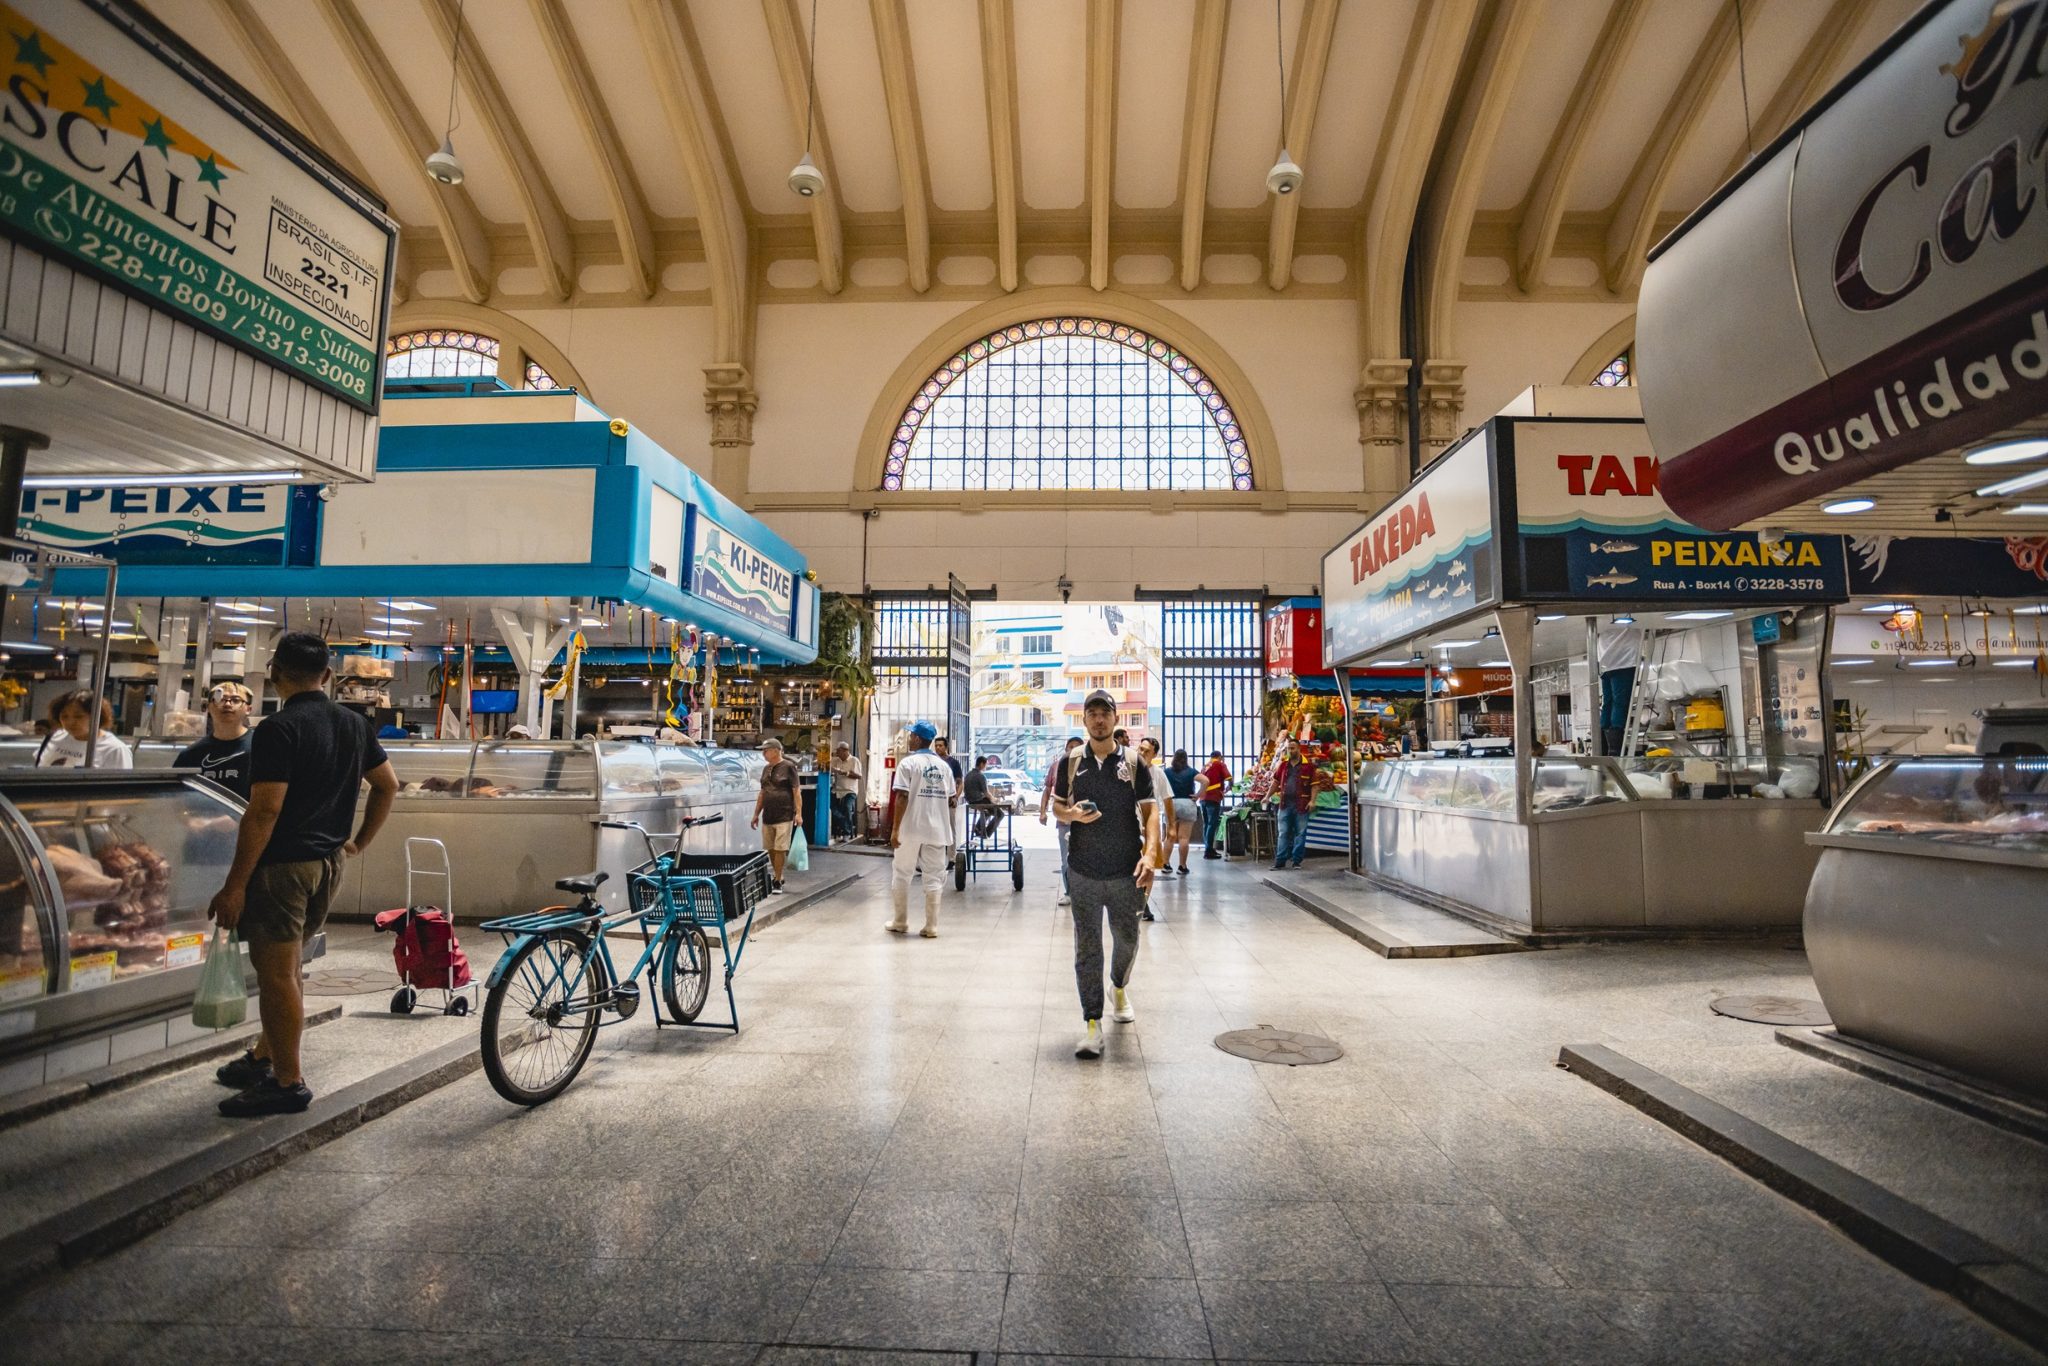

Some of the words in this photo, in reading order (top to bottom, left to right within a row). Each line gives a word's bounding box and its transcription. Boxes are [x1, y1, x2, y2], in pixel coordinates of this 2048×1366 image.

[4, 74, 237, 255] SCALE
[50, 183, 209, 284] Alimentos
[215, 270, 295, 331] Bovino
[301, 325, 313, 341] e
[316, 329, 370, 373] Suíno
[277, 218, 335, 267] BRASIL
[340, 261, 373, 292] S.I.F.
[300, 257, 348, 300] 2221
[319, 228, 330, 241] DA
[330, 237, 379, 276] AGRICULTURA
[78, 232, 227, 321] 228-1809
[251, 323, 366, 394] 3313-3008
[269, 263, 369, 333] INSPECIONADO
[1774, 311, 2048, 475] Qualidad
[1557, 454, 1661, 497] TAK
[730, 541, 789, 600] KI-PEIXE
[1350, 490, 1436, 586] TAKEDA
[1653, 580, 1675, 590] Rua
[1678, 580, 1686, 589] A
[1696, 580, 1731, 590] Box14
[1750, 578, 1825, 590] 3228-3578
